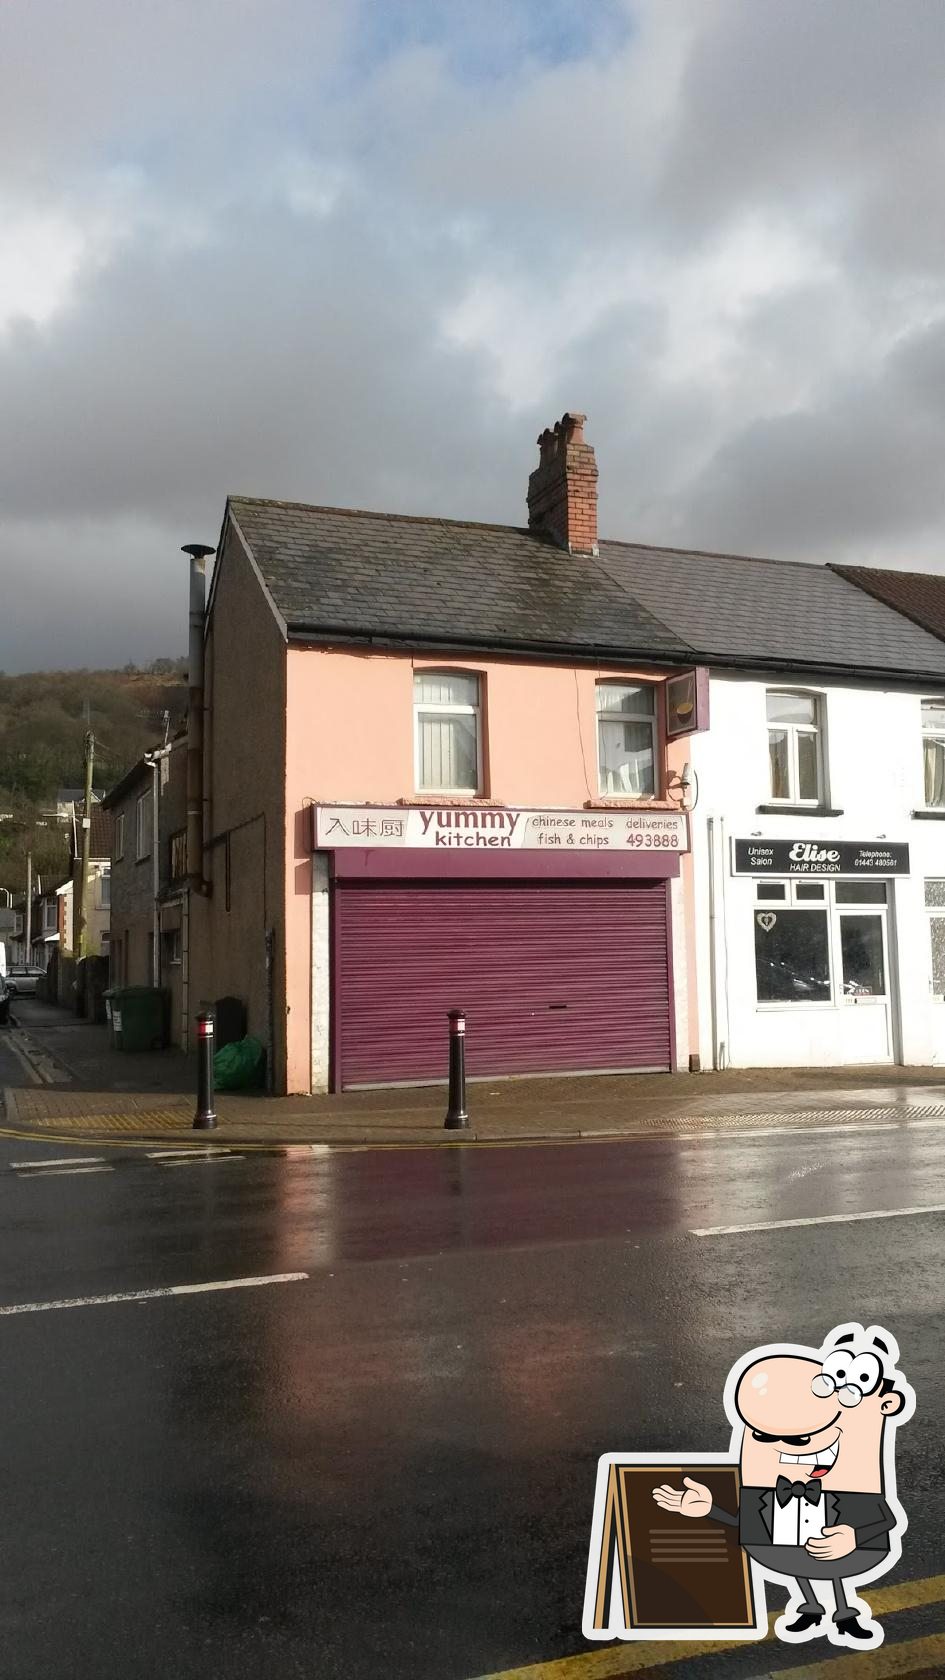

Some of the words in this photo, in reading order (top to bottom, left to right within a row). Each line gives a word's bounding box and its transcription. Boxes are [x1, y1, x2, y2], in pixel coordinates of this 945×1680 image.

[420, 811, 520, 836] yummy
[532, 816, 576, 827] chinese
[581, 817, 614, 828] meals
[626, 818, 678, 829] deliveries
[435, 831, 511, 847] kitchen
[538, 833, 561, 845] fish
[566, 834, 575, 845] &
[579, 834, 609, 848] chips
[626, 834, 679, 848] 493888
[748, 847, 774, 856] Unisex
[789, 843, 840, 862] Elise
[750, 857, 773, 866] Salon
[811, 864, 841, 872] DESIGN
